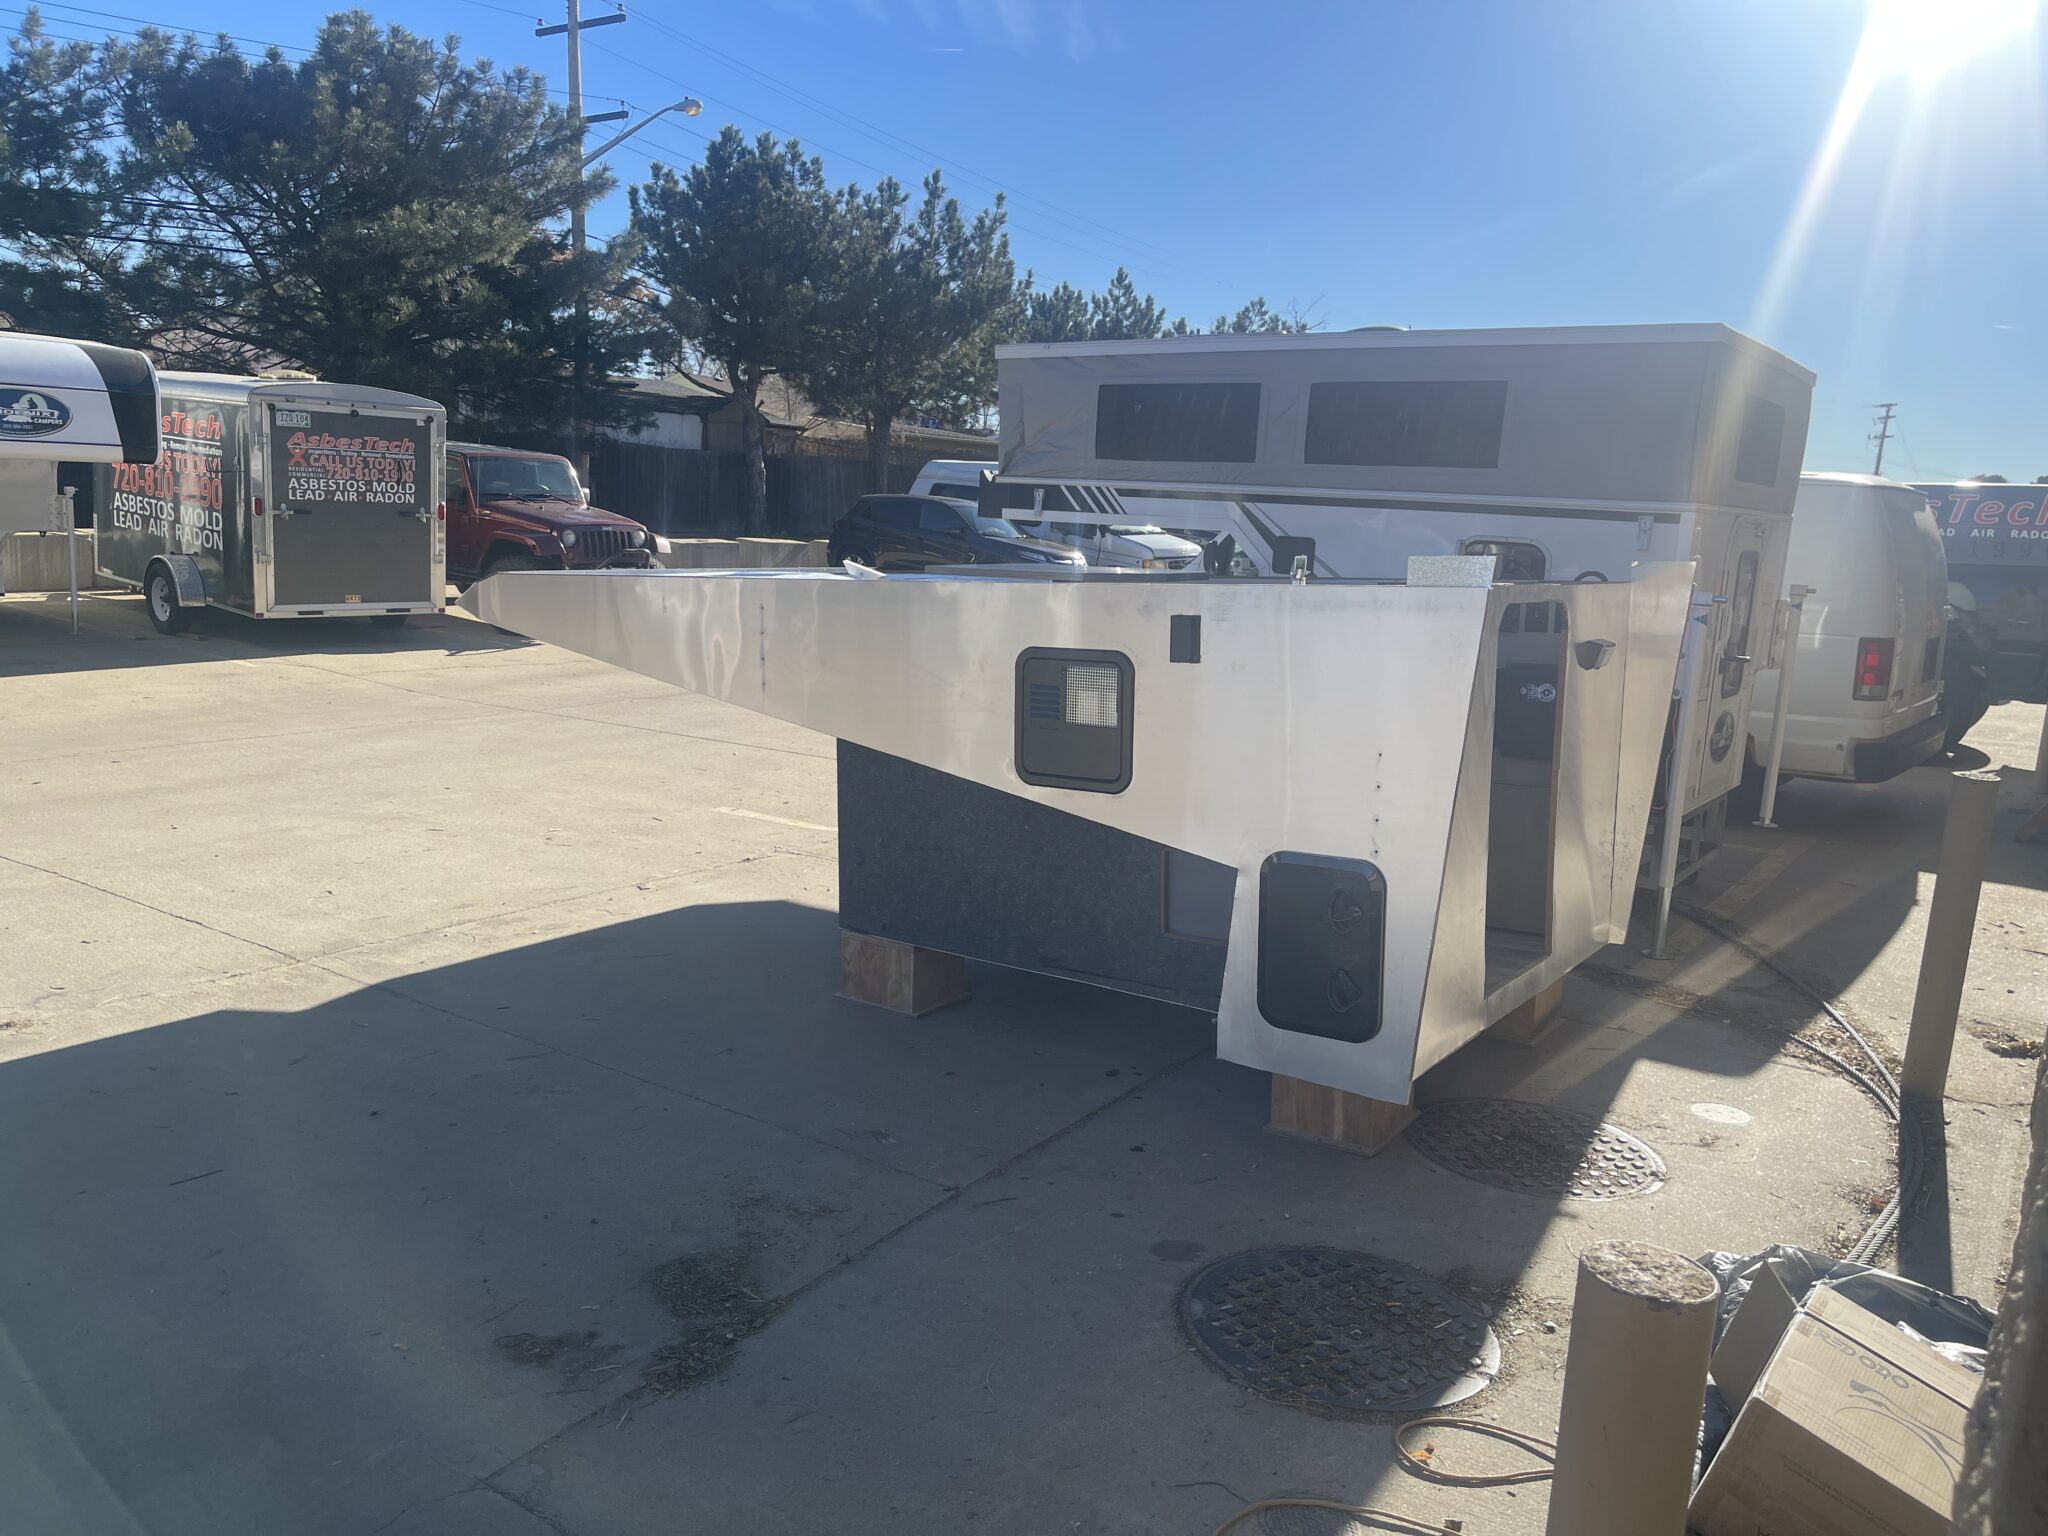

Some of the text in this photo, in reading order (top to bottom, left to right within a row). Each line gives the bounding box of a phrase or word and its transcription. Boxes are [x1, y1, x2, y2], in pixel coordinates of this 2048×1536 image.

[0, 409, 53, 417] OENIX
[191, 444, 223, 456] Remediation
[287, 431, 416, 454] AsbesTech
[309, 454, 417, 472] CALL US TODY!
[111, 462, 223, 510] 720-810-1990
[288, 477, 416, 494] ASBESTOS MOLD
[288, 489, 415, 504] LEAD AIR RADON
[113, 491, 223, 531] ASBESTOS MOLD
[113, 510, 223, 551] LEAD AIR RADON
[1970, 528, 1995, 538] AIR
